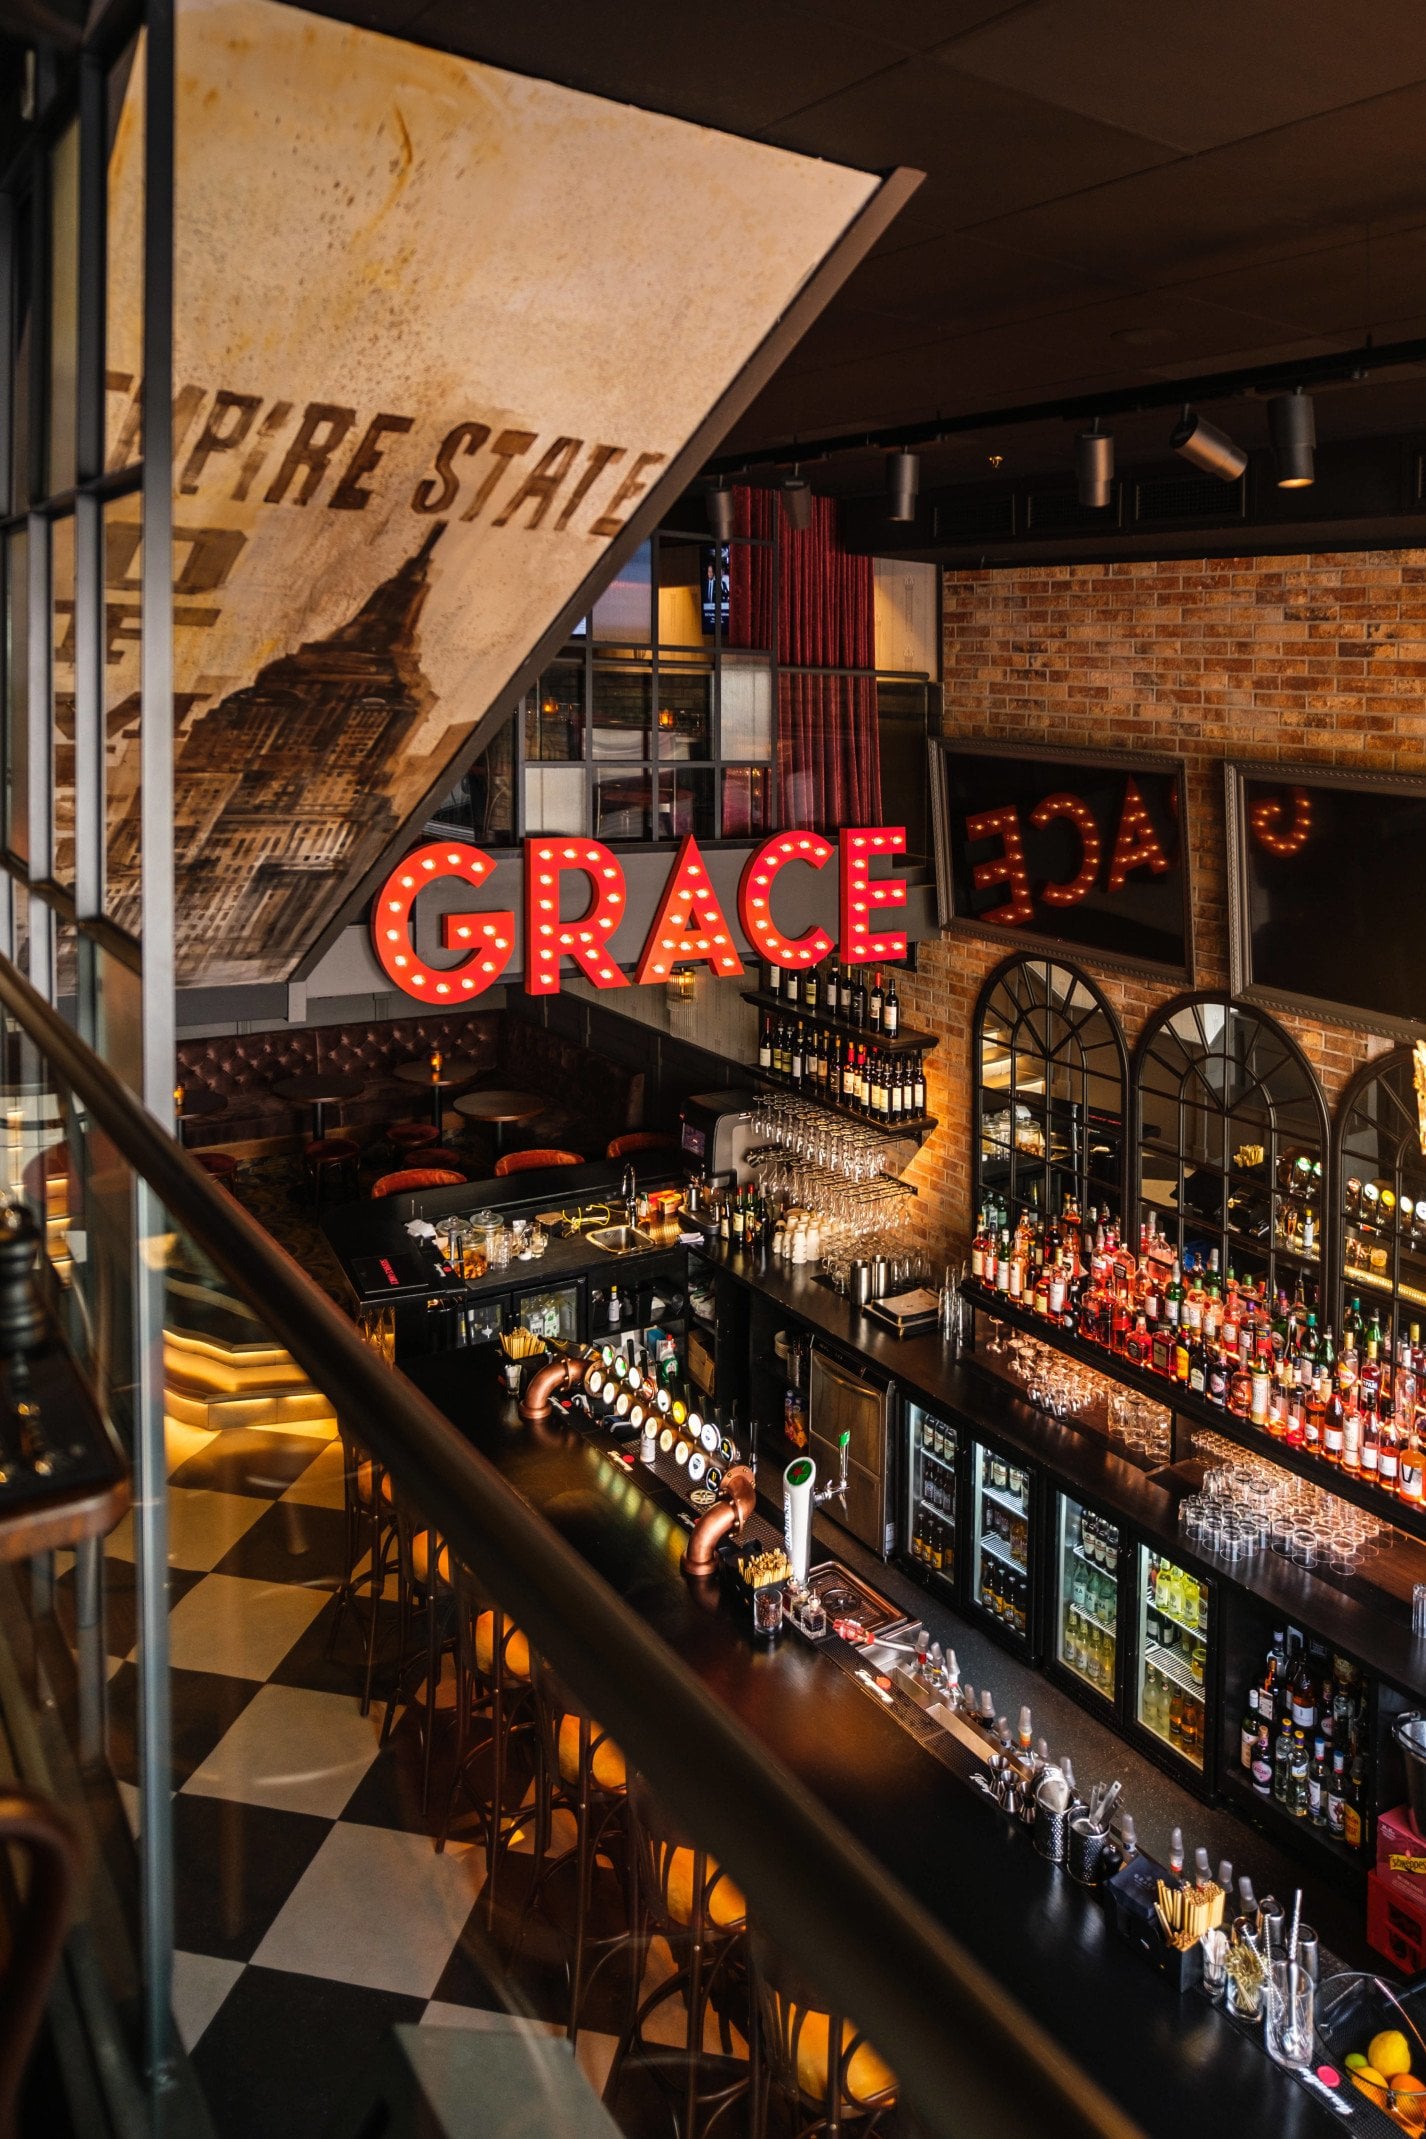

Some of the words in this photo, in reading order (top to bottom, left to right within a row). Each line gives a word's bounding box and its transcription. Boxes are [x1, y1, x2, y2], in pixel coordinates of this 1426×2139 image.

[104, 371, 414, 510] MPIRE
[411, 421, 665, 536] STATE
[371, 826, 908, 1005] GRACE
